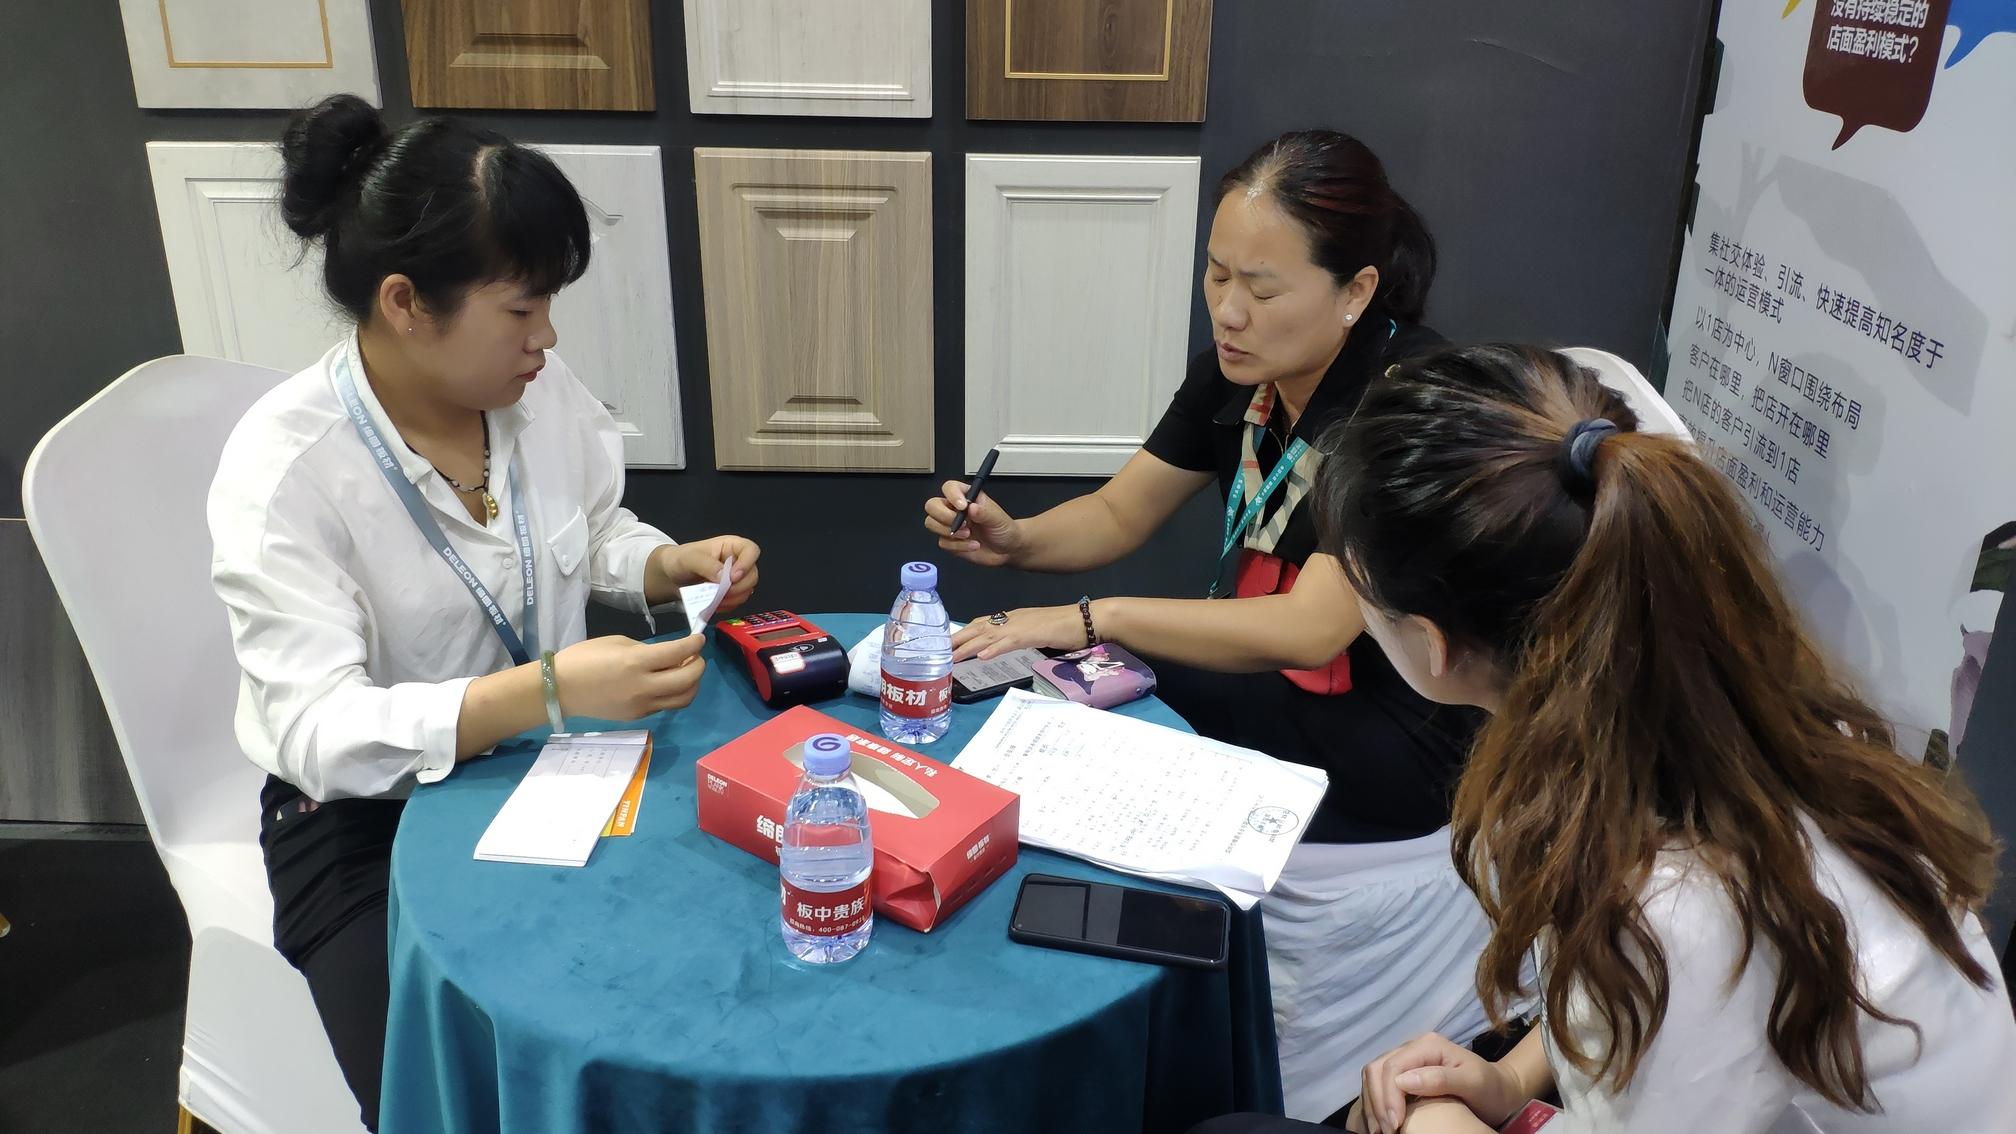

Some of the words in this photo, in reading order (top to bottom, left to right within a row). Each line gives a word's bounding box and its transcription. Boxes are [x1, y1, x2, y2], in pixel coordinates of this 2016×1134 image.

[1830, 0, 1930, 28] 没有持续稳定的
[1704, 265, 1785, 324] 一体的运营模式
[443, 547, 478, 588] DELEON
[525, 559, 534, 606] DELEON
[797, 896, 864, 922] 板中贵族
